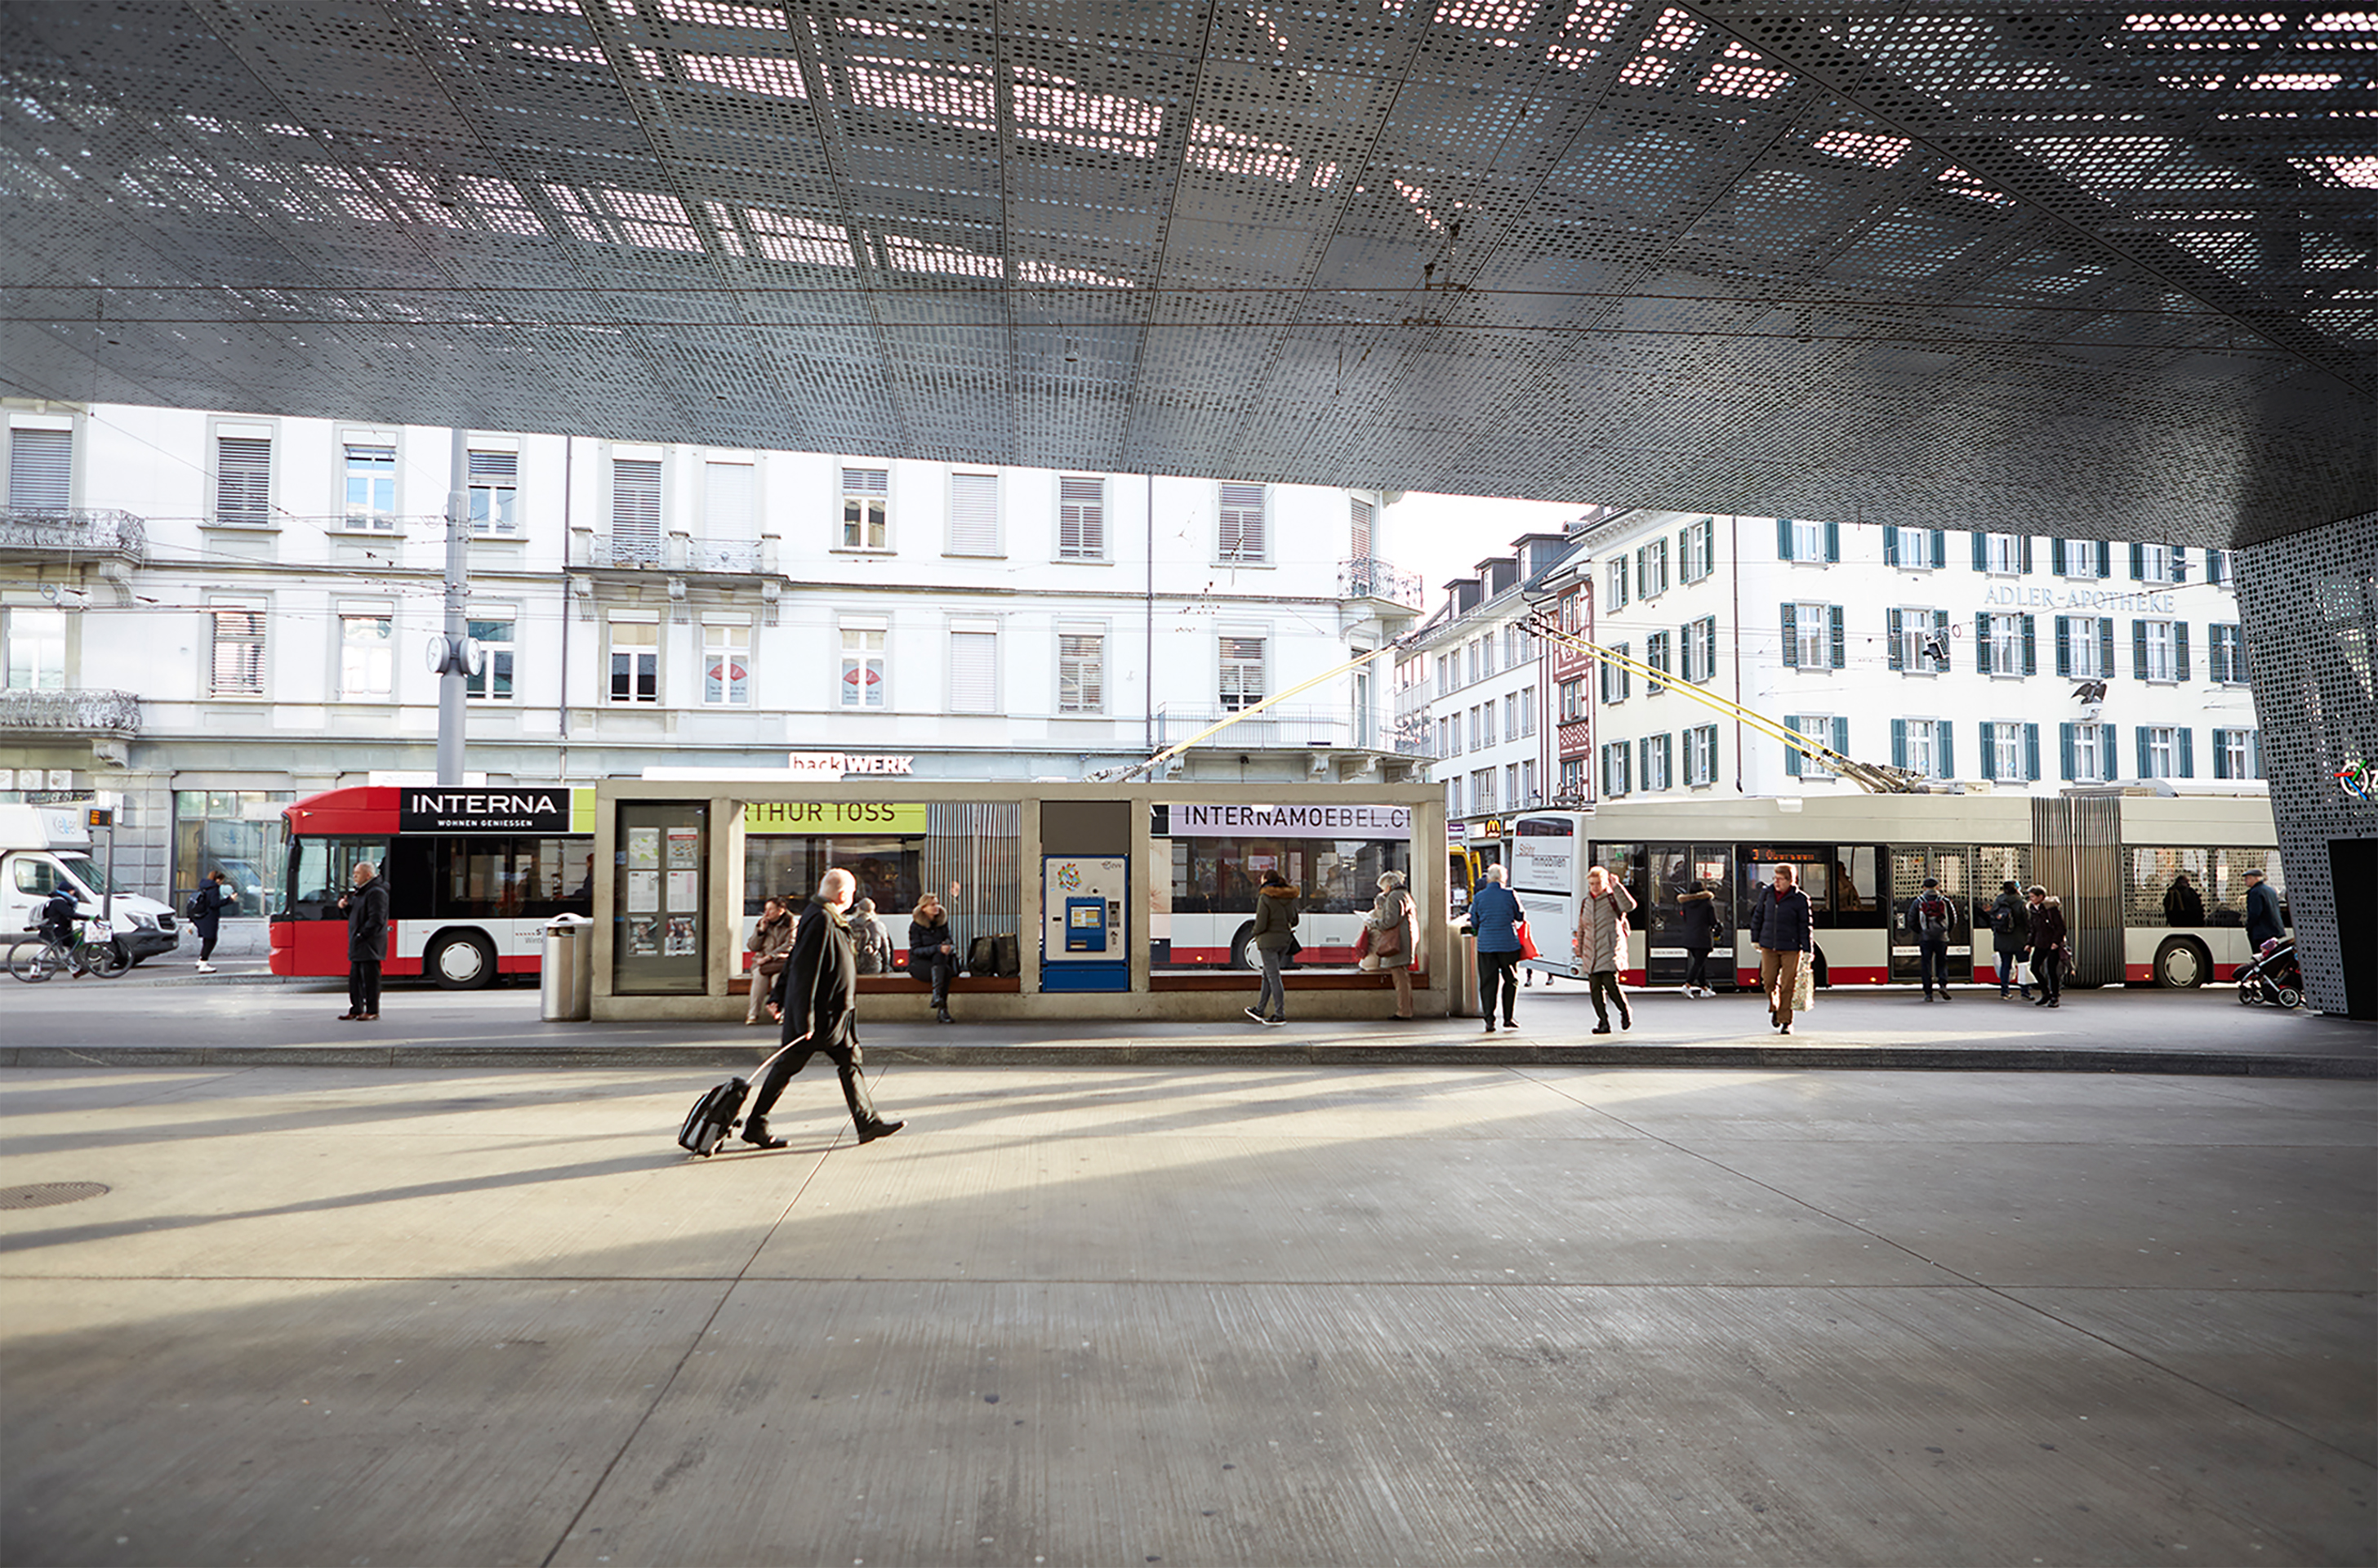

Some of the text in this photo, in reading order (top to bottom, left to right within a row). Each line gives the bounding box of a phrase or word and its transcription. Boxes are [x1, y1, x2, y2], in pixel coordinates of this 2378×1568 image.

[1984, 585, 2175, 612] ADLER-APOTHEKE
[412, 795, 557, 813] INTERNA
[437, 819, 533, 827] WOHNEN GENIESSEN
[1752, 849, 1759, 861] 3
